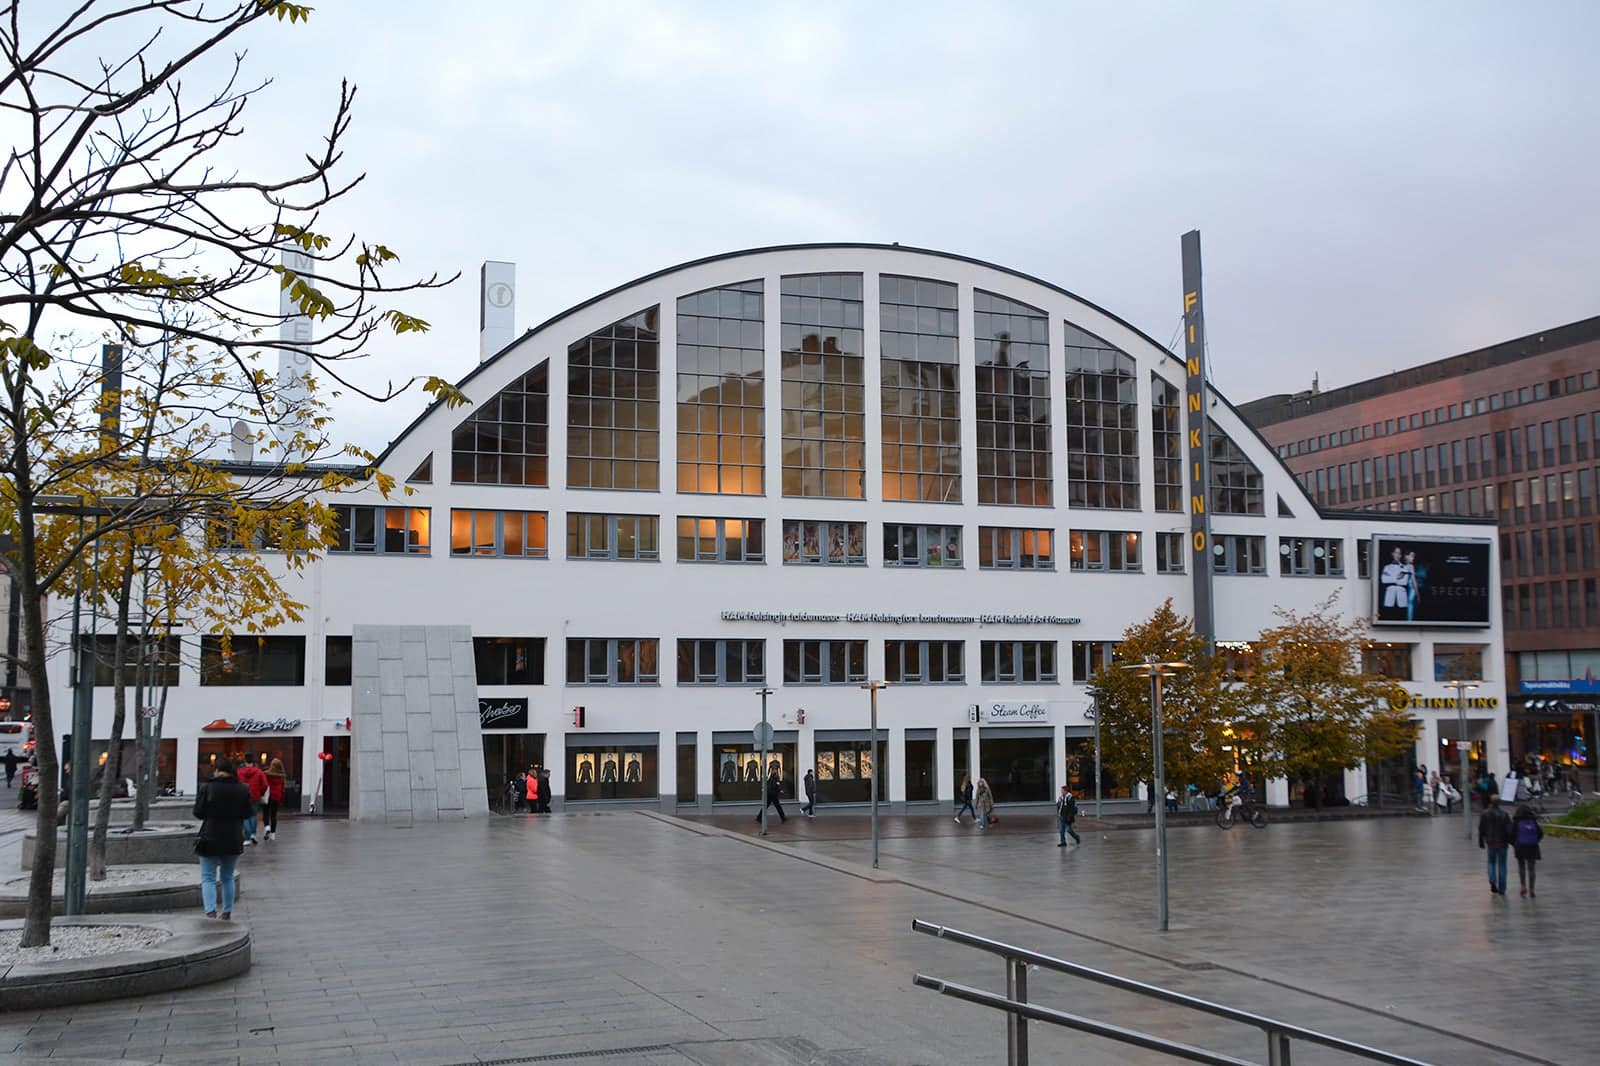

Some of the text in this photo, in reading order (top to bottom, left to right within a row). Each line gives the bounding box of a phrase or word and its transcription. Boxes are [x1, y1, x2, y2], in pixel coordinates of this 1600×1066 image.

[1184, 291, 1206, 552] FINNKINO
[721, 611, 745, 621] HAM
[846, 613, 869, 623] HAM
[980, 614, 1001, 624] HAM
[1412, 697, 1498, 709] FINNINO
[990, 704, 1018, 717] Steam
[1019, 704, 1046, 719] Coffee
[235, 718, 301, 733] Pizza Hut
